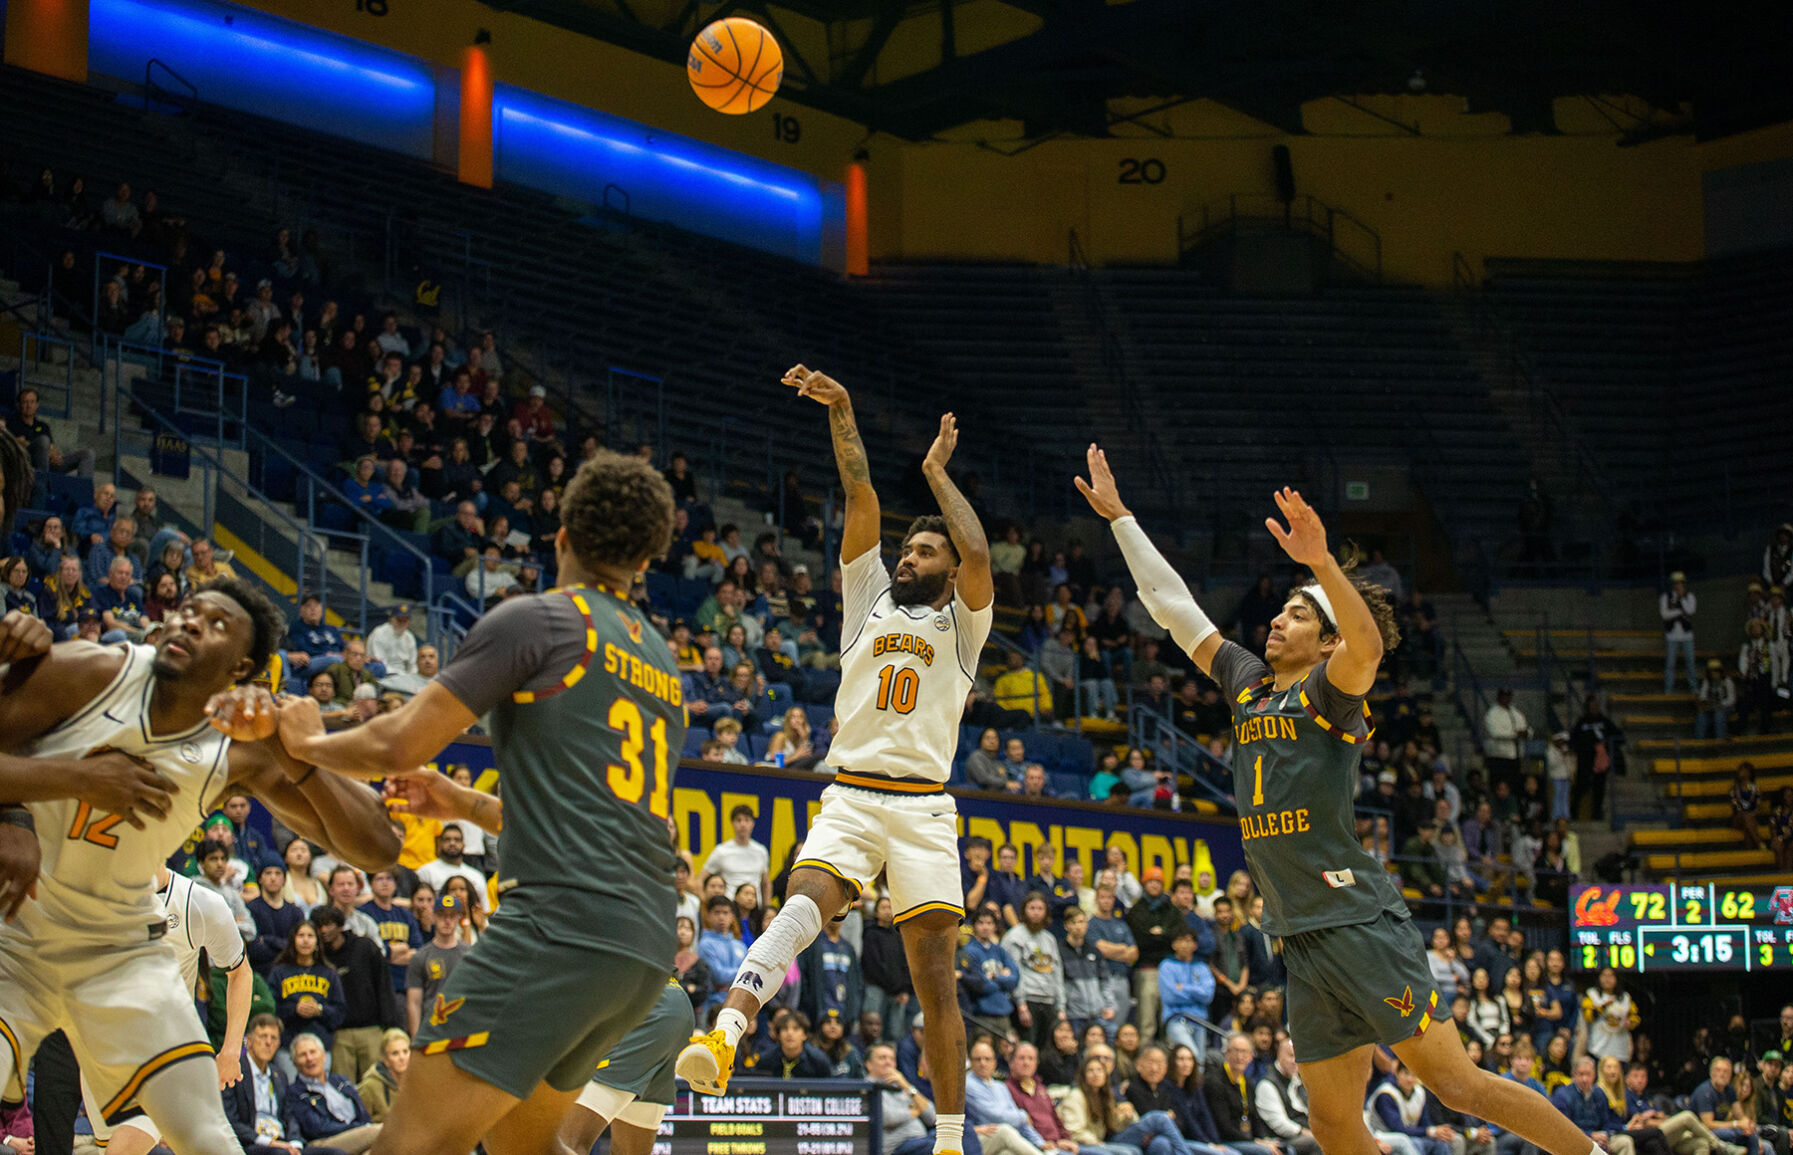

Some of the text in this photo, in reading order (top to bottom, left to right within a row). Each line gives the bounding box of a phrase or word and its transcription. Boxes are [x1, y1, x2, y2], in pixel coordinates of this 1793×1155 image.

[772, 112, 801, 144] 19
[1117, 157, 1167, 185] 20
[873, 633, 935, 667] BEARS
[604, 642, 682, 707] STRONG
[876, 664, 920, 715] 10
[1235, 715, 1298, 745] OSTON
[606, 697, 669, 820] 31
[1252, 754, 1265, 807] 1
[1240, 808, 1311, 841] OLLEGE
[1335, 873, 1345, 883] L
[1574, 886, 1622, 927] Cal
[1629, 892, 1666, 920] 72
[1680, 886, 1705, 900] PER
[1721, 891, 1756, 919] 62
[1685, 900, 1702, 924] 2
[1583, 945, 1598, 969] 2
[1608, 945, 1636, 968] 10
[1671, 934, 1733, 964] 3:15
[1759, 944, 1774, 967] 3
[701, 1096, 772, 1113] TEAM STATS
[707, 1142, 730, 1155] FREE
